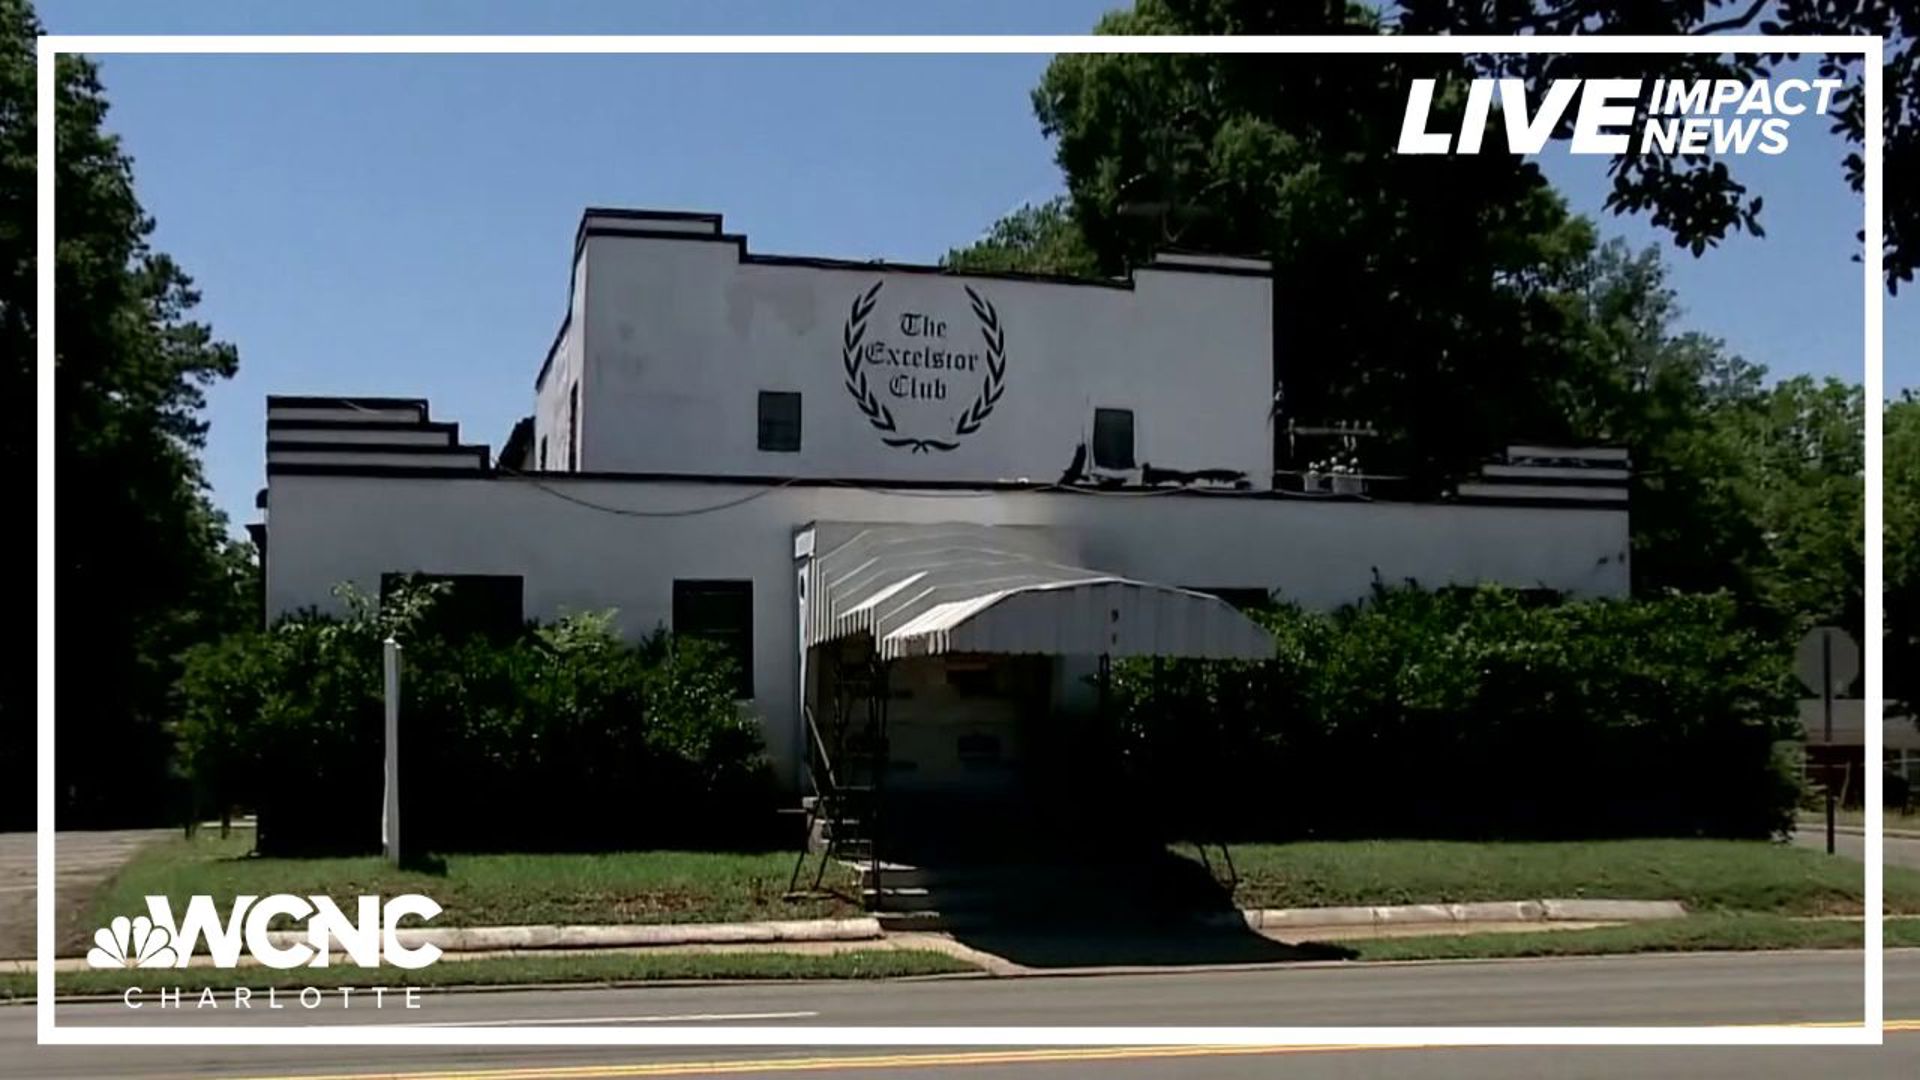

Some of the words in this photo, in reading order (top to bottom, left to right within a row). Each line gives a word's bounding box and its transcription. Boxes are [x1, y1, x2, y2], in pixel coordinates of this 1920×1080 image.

[900, 312, 948, 338] The
[864, 341, 980, 372] Excelsior
[888, 374, 948, 401] Club
